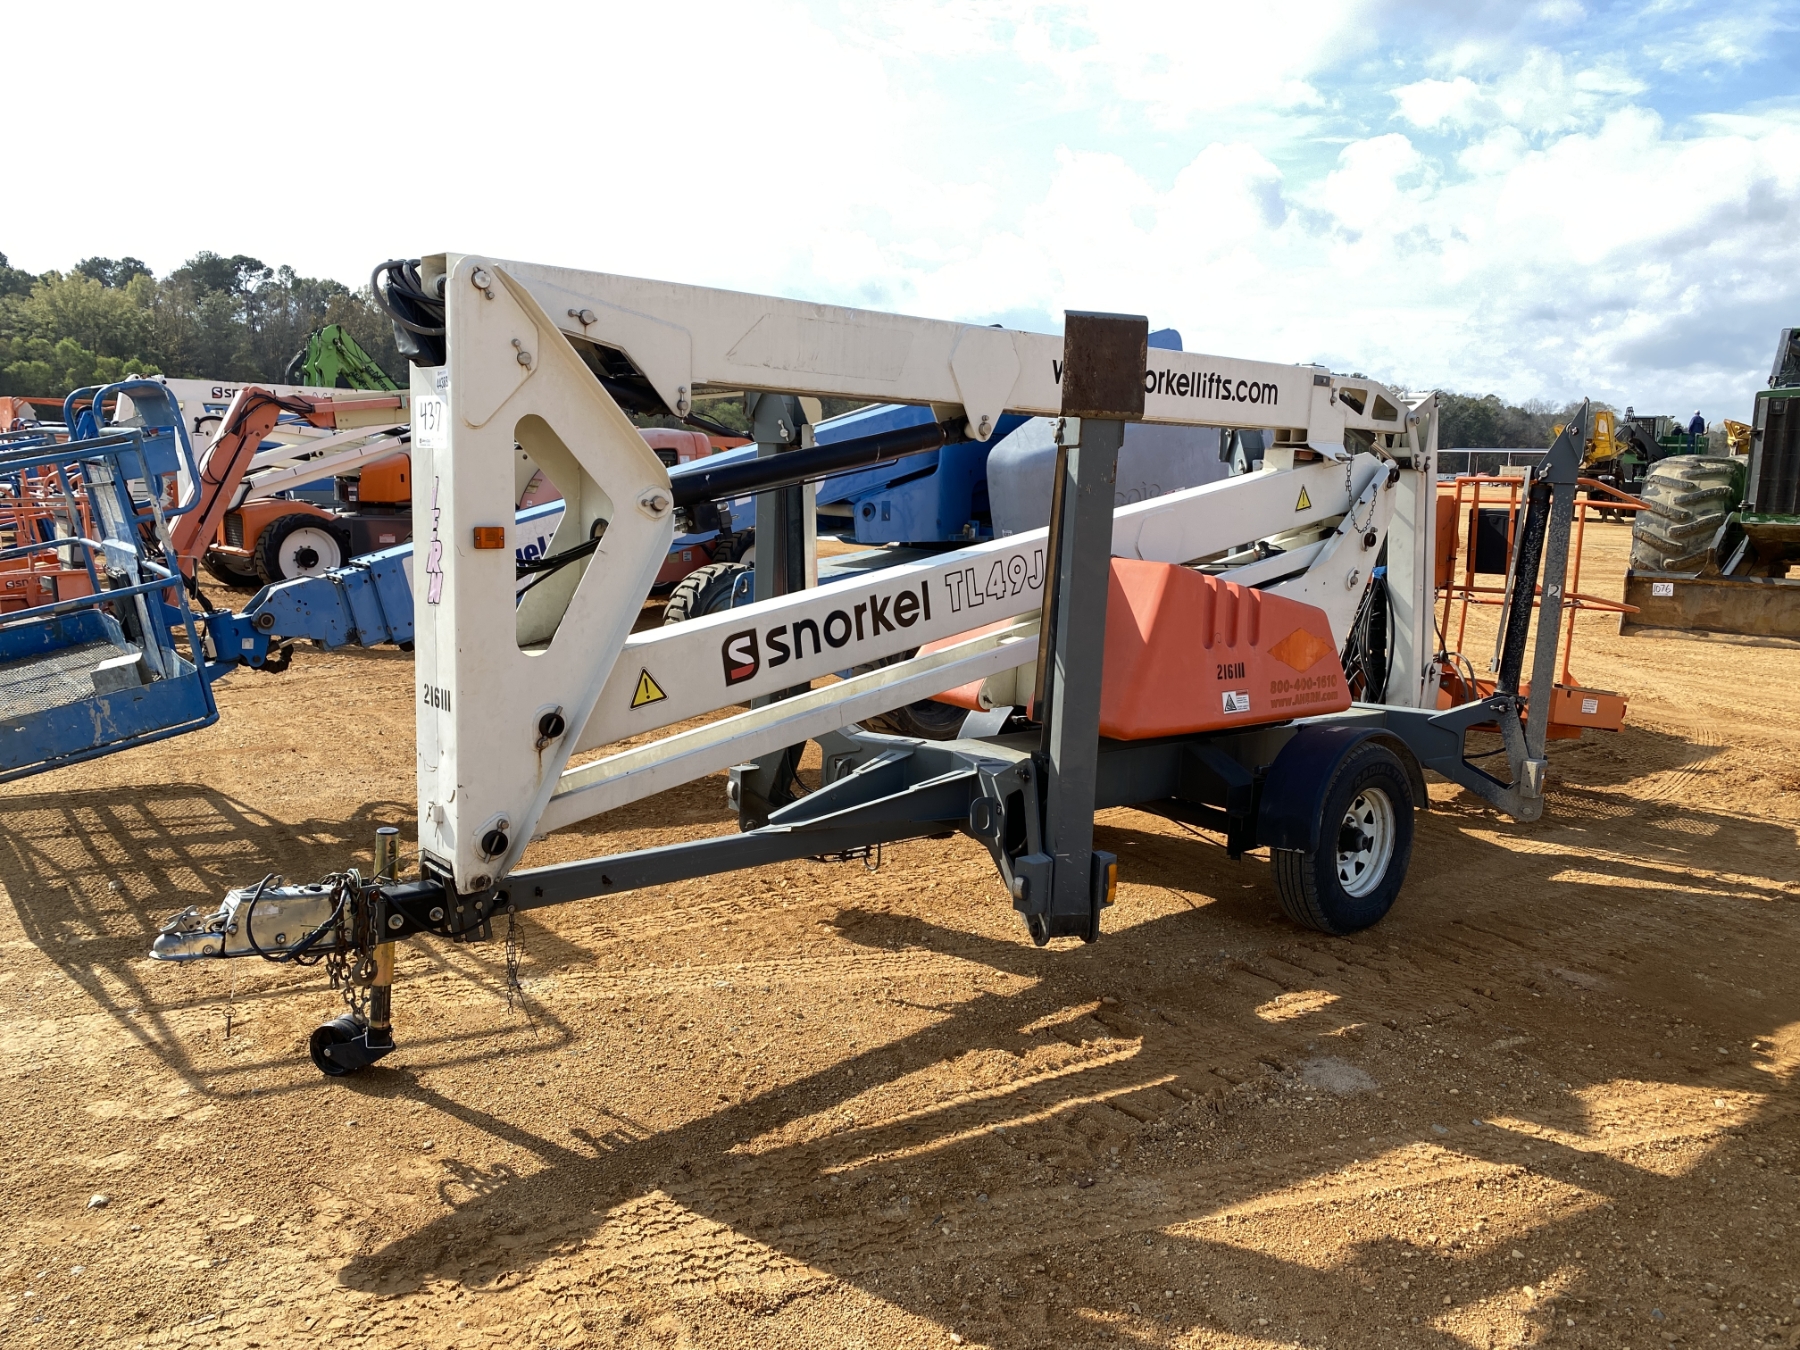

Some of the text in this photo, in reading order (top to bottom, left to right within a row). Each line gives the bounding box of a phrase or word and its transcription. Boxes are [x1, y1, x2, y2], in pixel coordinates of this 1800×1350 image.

[420, 402, 442, 431] 437
[765, 580, 931, 669] snorkel
[944, 549, 1045, 613] TL49J
[1270, 674, 1337, 694] 800-400-1610
